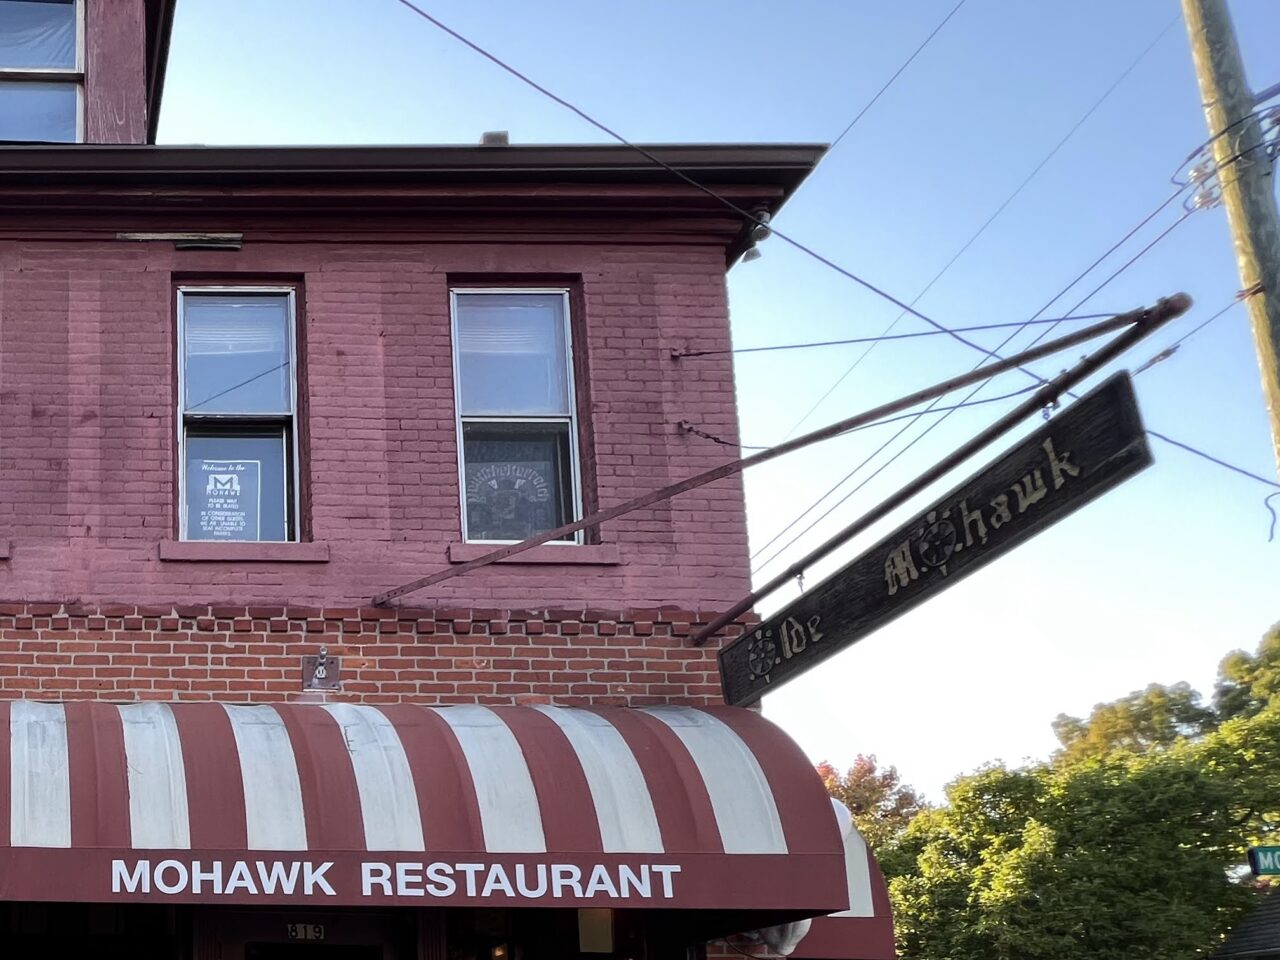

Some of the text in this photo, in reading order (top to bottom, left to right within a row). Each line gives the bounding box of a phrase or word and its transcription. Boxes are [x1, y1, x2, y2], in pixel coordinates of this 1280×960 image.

[883, 436, 1081, 596] Mohawk
[110, 859, 682, 899] MOHAWK RESTAURANT
[289, 923, 322, 941] 819
